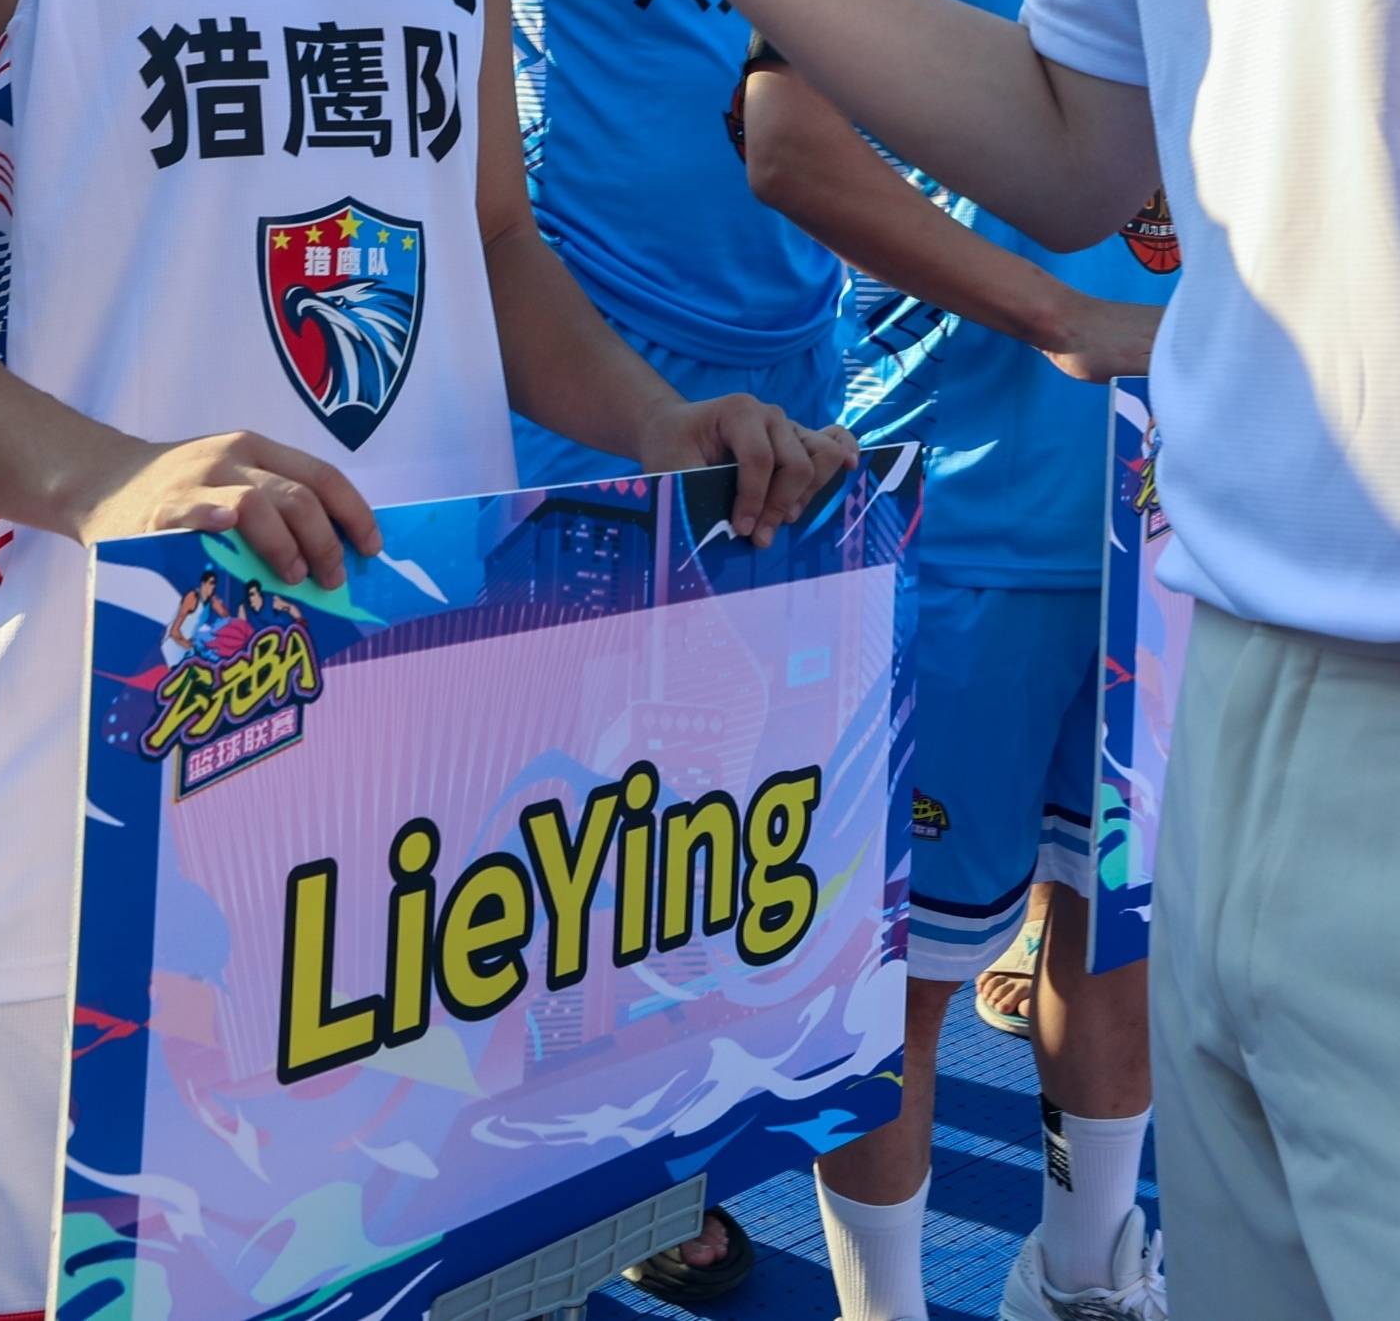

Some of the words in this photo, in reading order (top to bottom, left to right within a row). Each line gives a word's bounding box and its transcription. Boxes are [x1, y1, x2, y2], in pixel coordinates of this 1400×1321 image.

[137, 16, 462, 169] 猎鹰队
[304, 246, 388, 276] 猎鹰队
[147, 630, 317, 749] 公元BA
[188, 708, 296, 783] 篮球联赛
[279, 761, 821, 1084] LieYing
